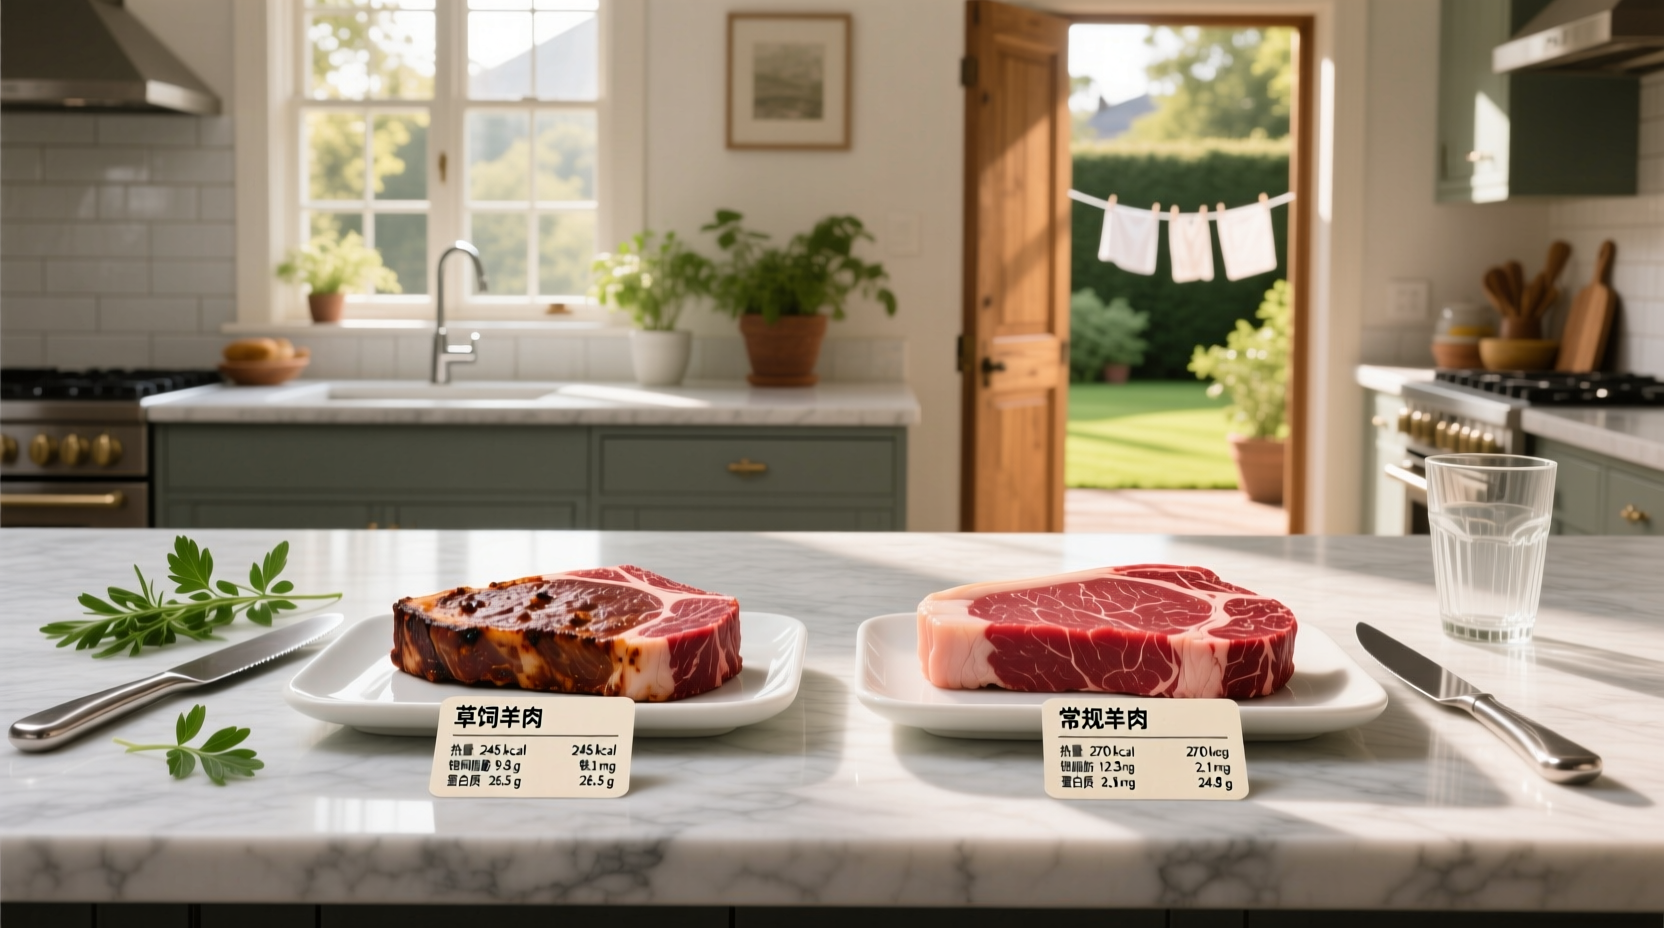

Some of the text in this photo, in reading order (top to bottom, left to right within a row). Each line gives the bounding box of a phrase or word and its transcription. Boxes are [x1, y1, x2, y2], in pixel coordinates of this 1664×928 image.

[454, 704, 543, 729] 草饲羊肉
[1059, 706, 1148, 730] 常规羊肉
